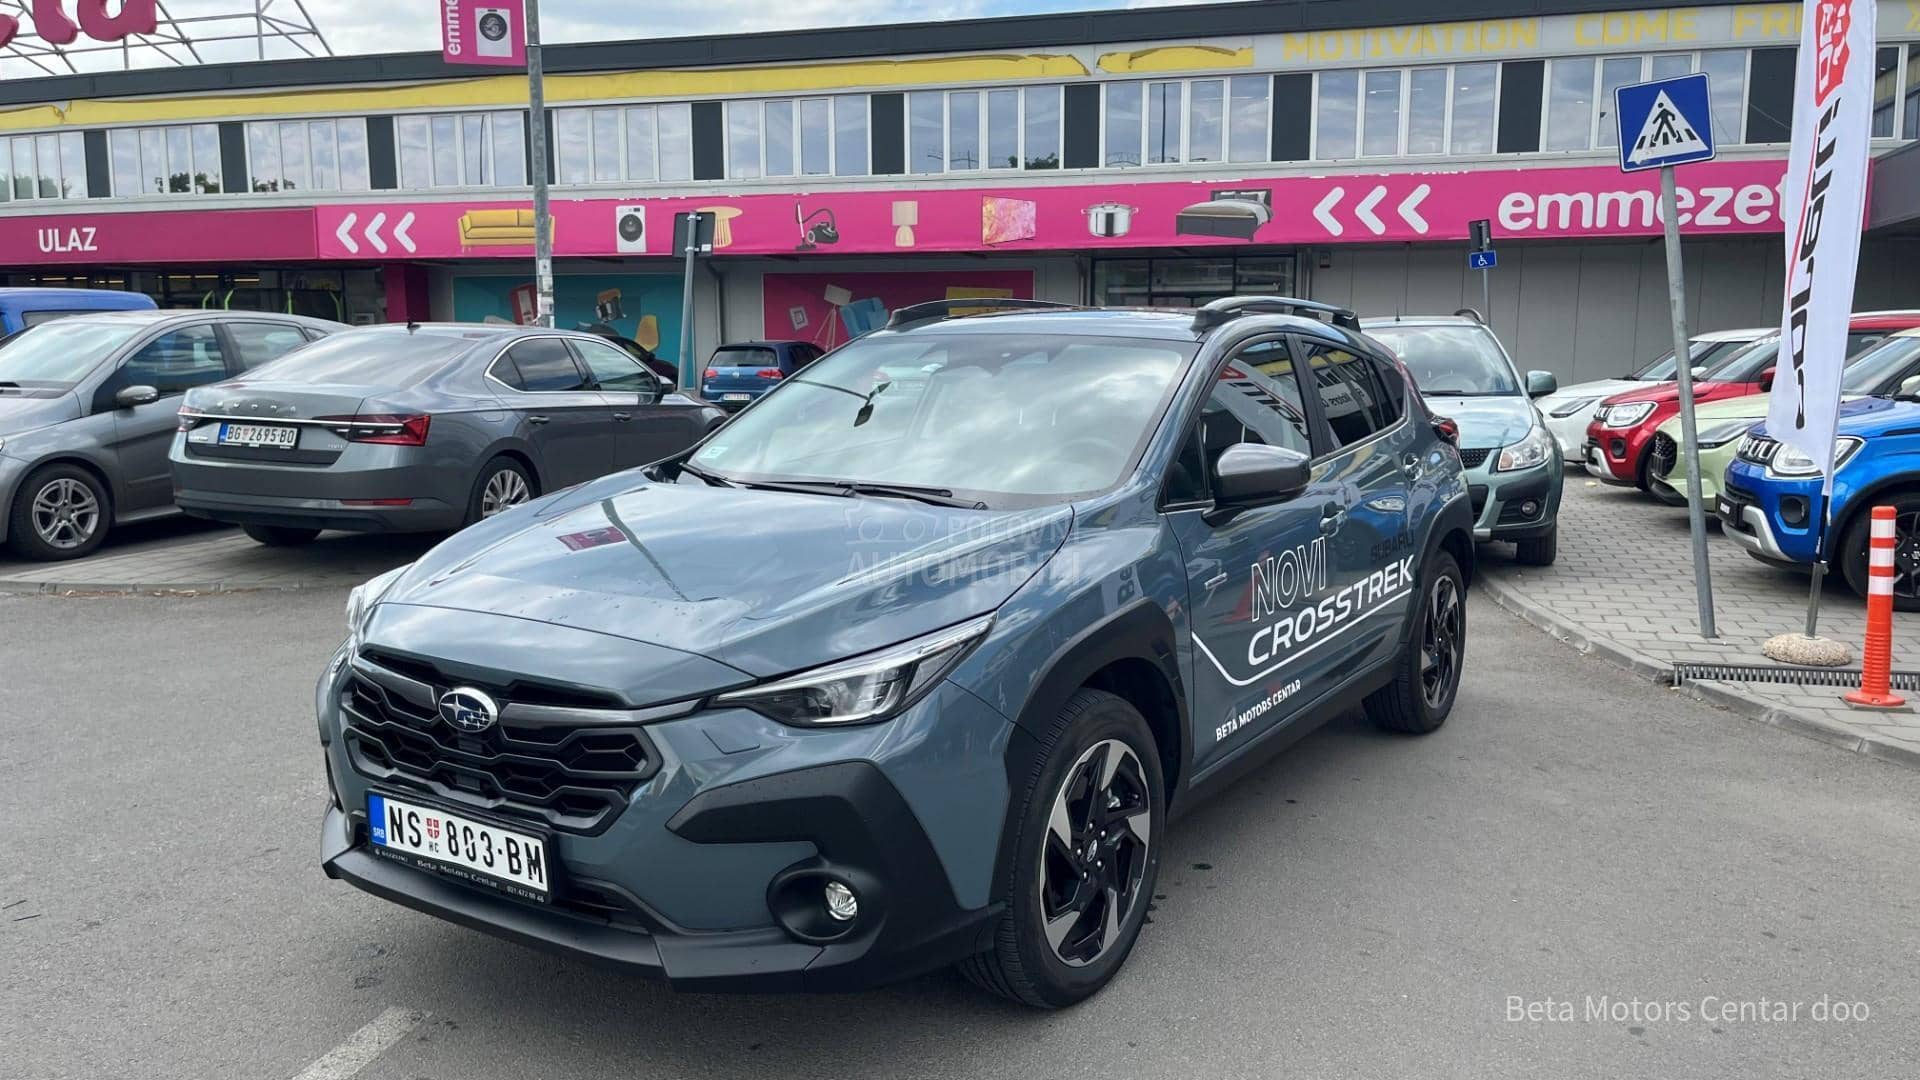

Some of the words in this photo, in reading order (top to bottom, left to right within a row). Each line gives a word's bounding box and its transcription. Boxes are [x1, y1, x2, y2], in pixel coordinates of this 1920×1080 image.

[1283, 17, 1539, 62] MOTIVATION
[1574, 11, 1698, 46] COME
[38, 227, 98, 253] ULAZ
[227, 426, 241, 440] BG
[1251, 536, 1326, 622] NOVI
[1248, 554, 1414, 665] CROSSTREK
[1216, 718, 1238, 742] BETA
[1238, 697, 1272, 728] MOTORS
[1272, 679, 1301, 706] CENTAR
[389, 805, 422, 848] NS
